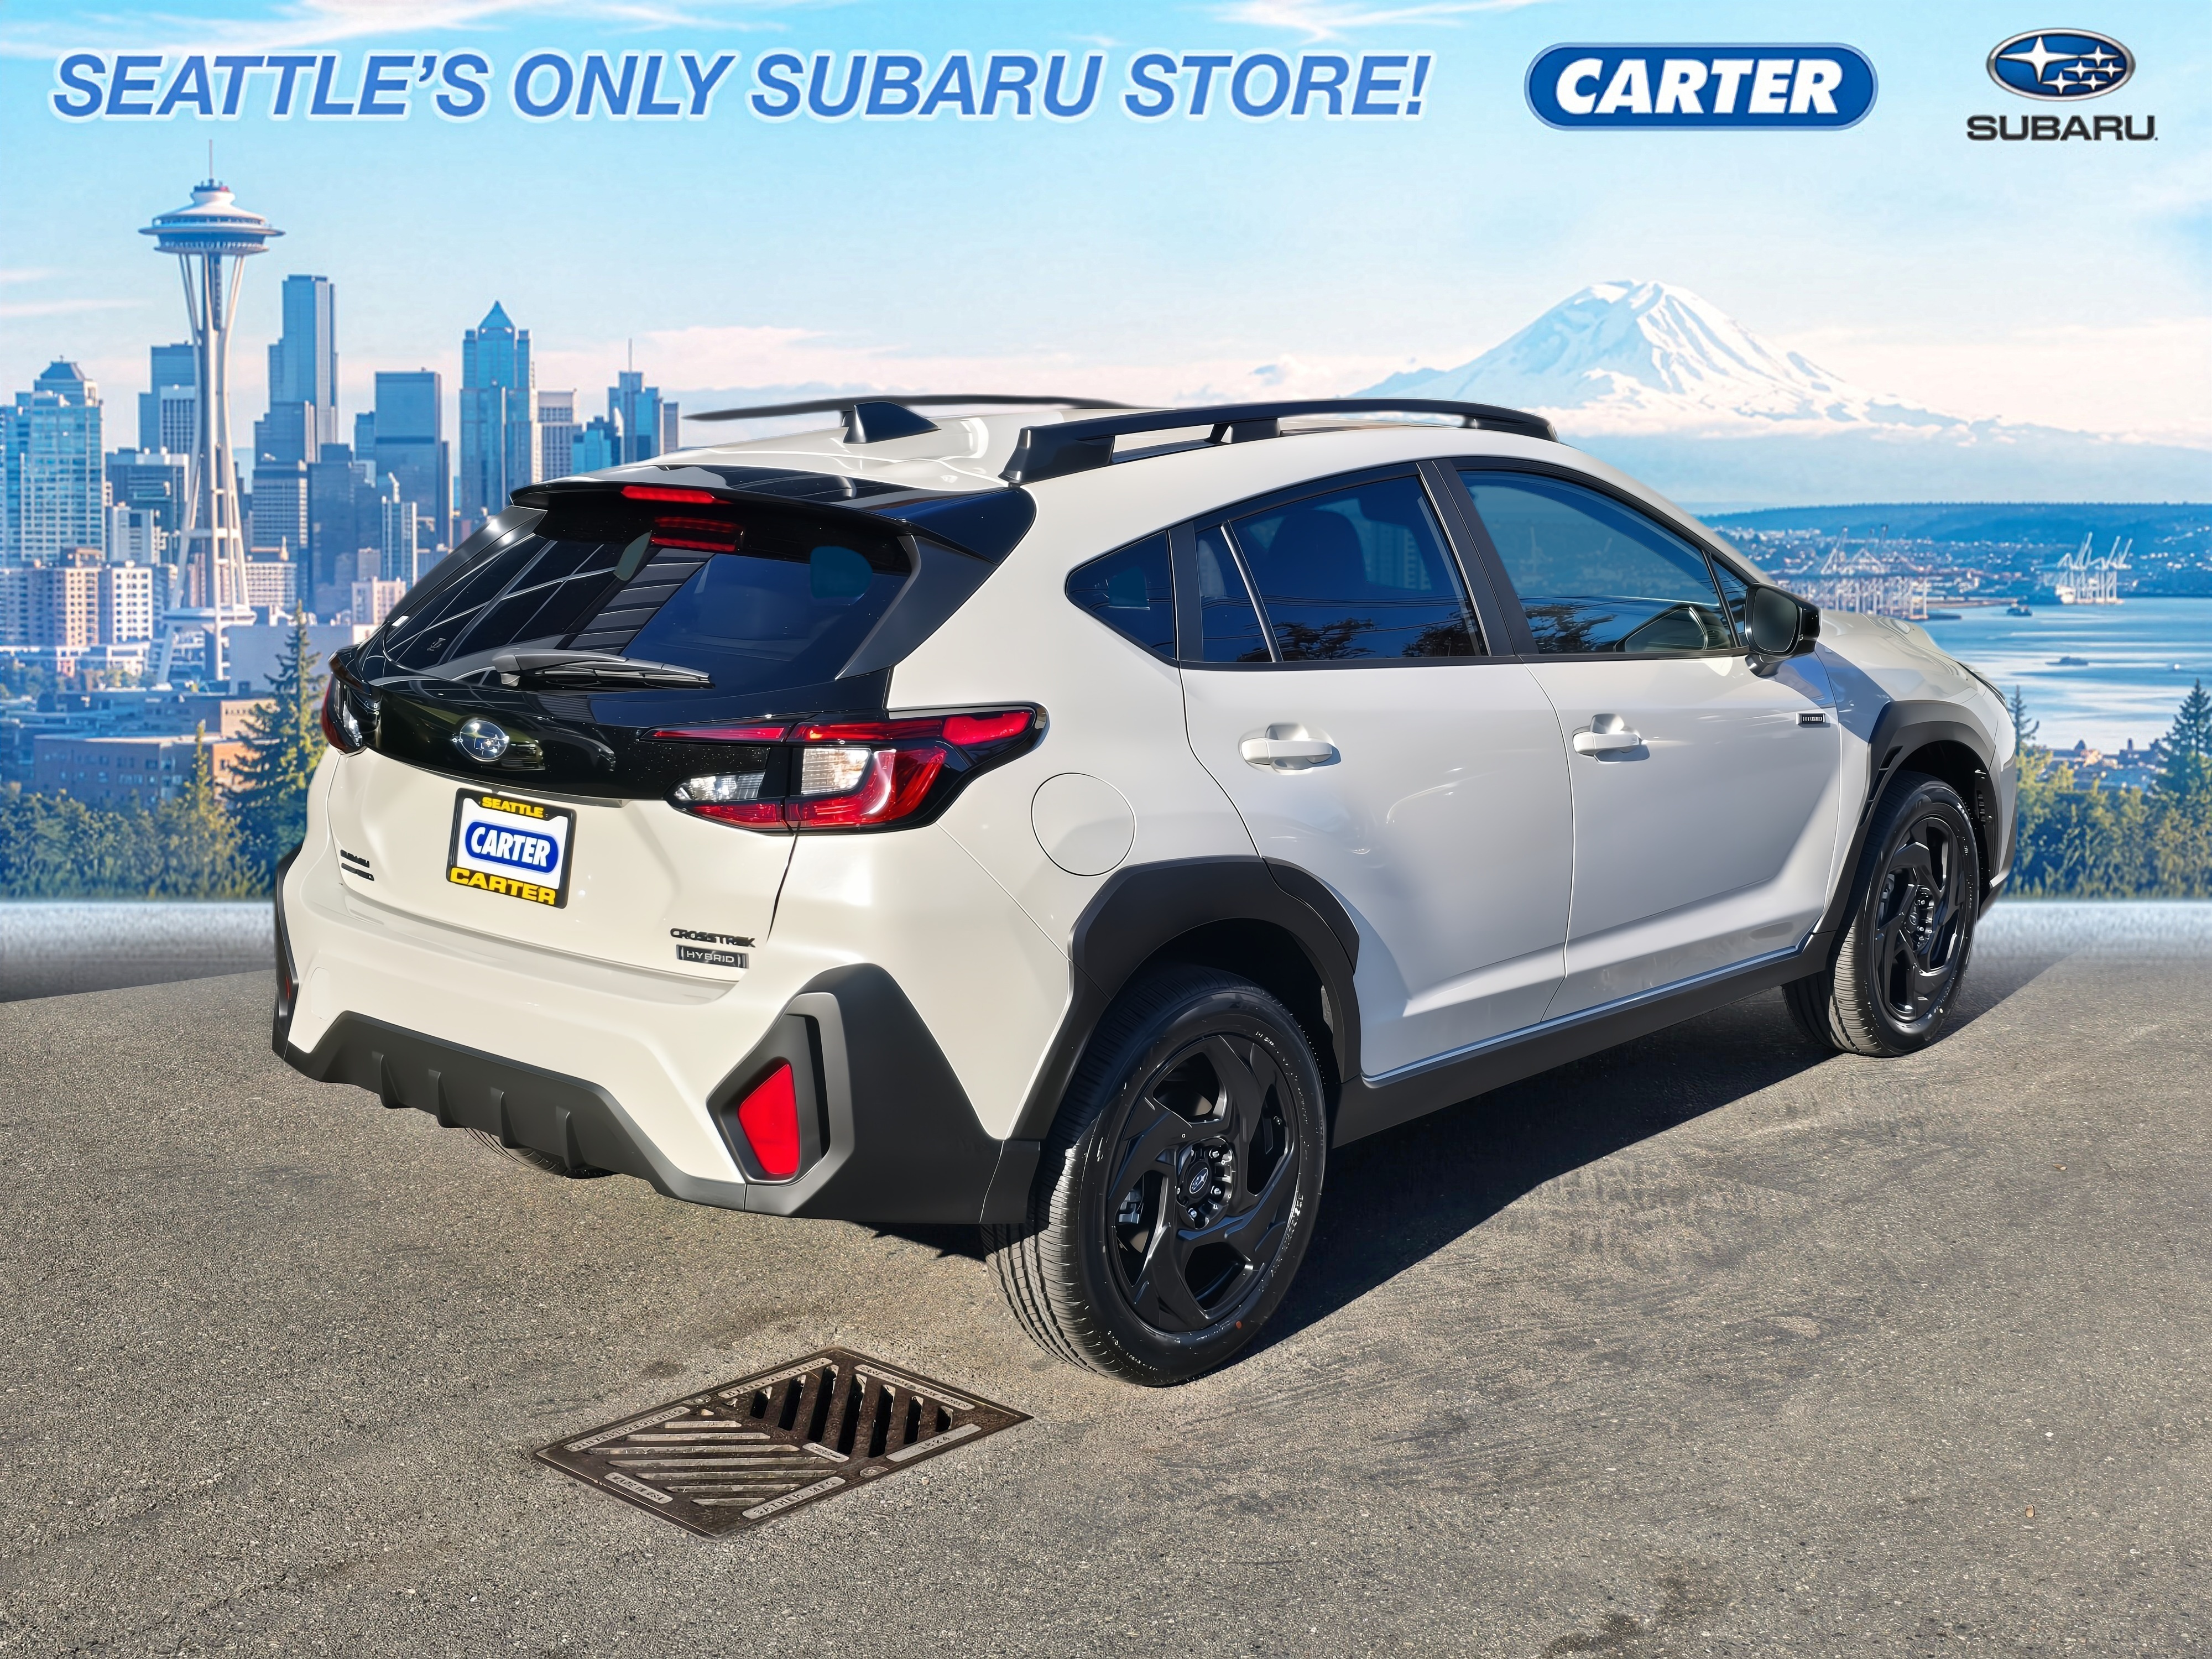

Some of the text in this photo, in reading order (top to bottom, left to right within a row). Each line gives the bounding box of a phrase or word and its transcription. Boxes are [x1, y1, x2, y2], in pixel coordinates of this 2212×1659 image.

[482, 797, 544, 818] SEATTLE
[471, 827, 551, 867] CARTER
[450, 867, 556, 905] CARTER
[686, 950, 735, 963] HYBRID
